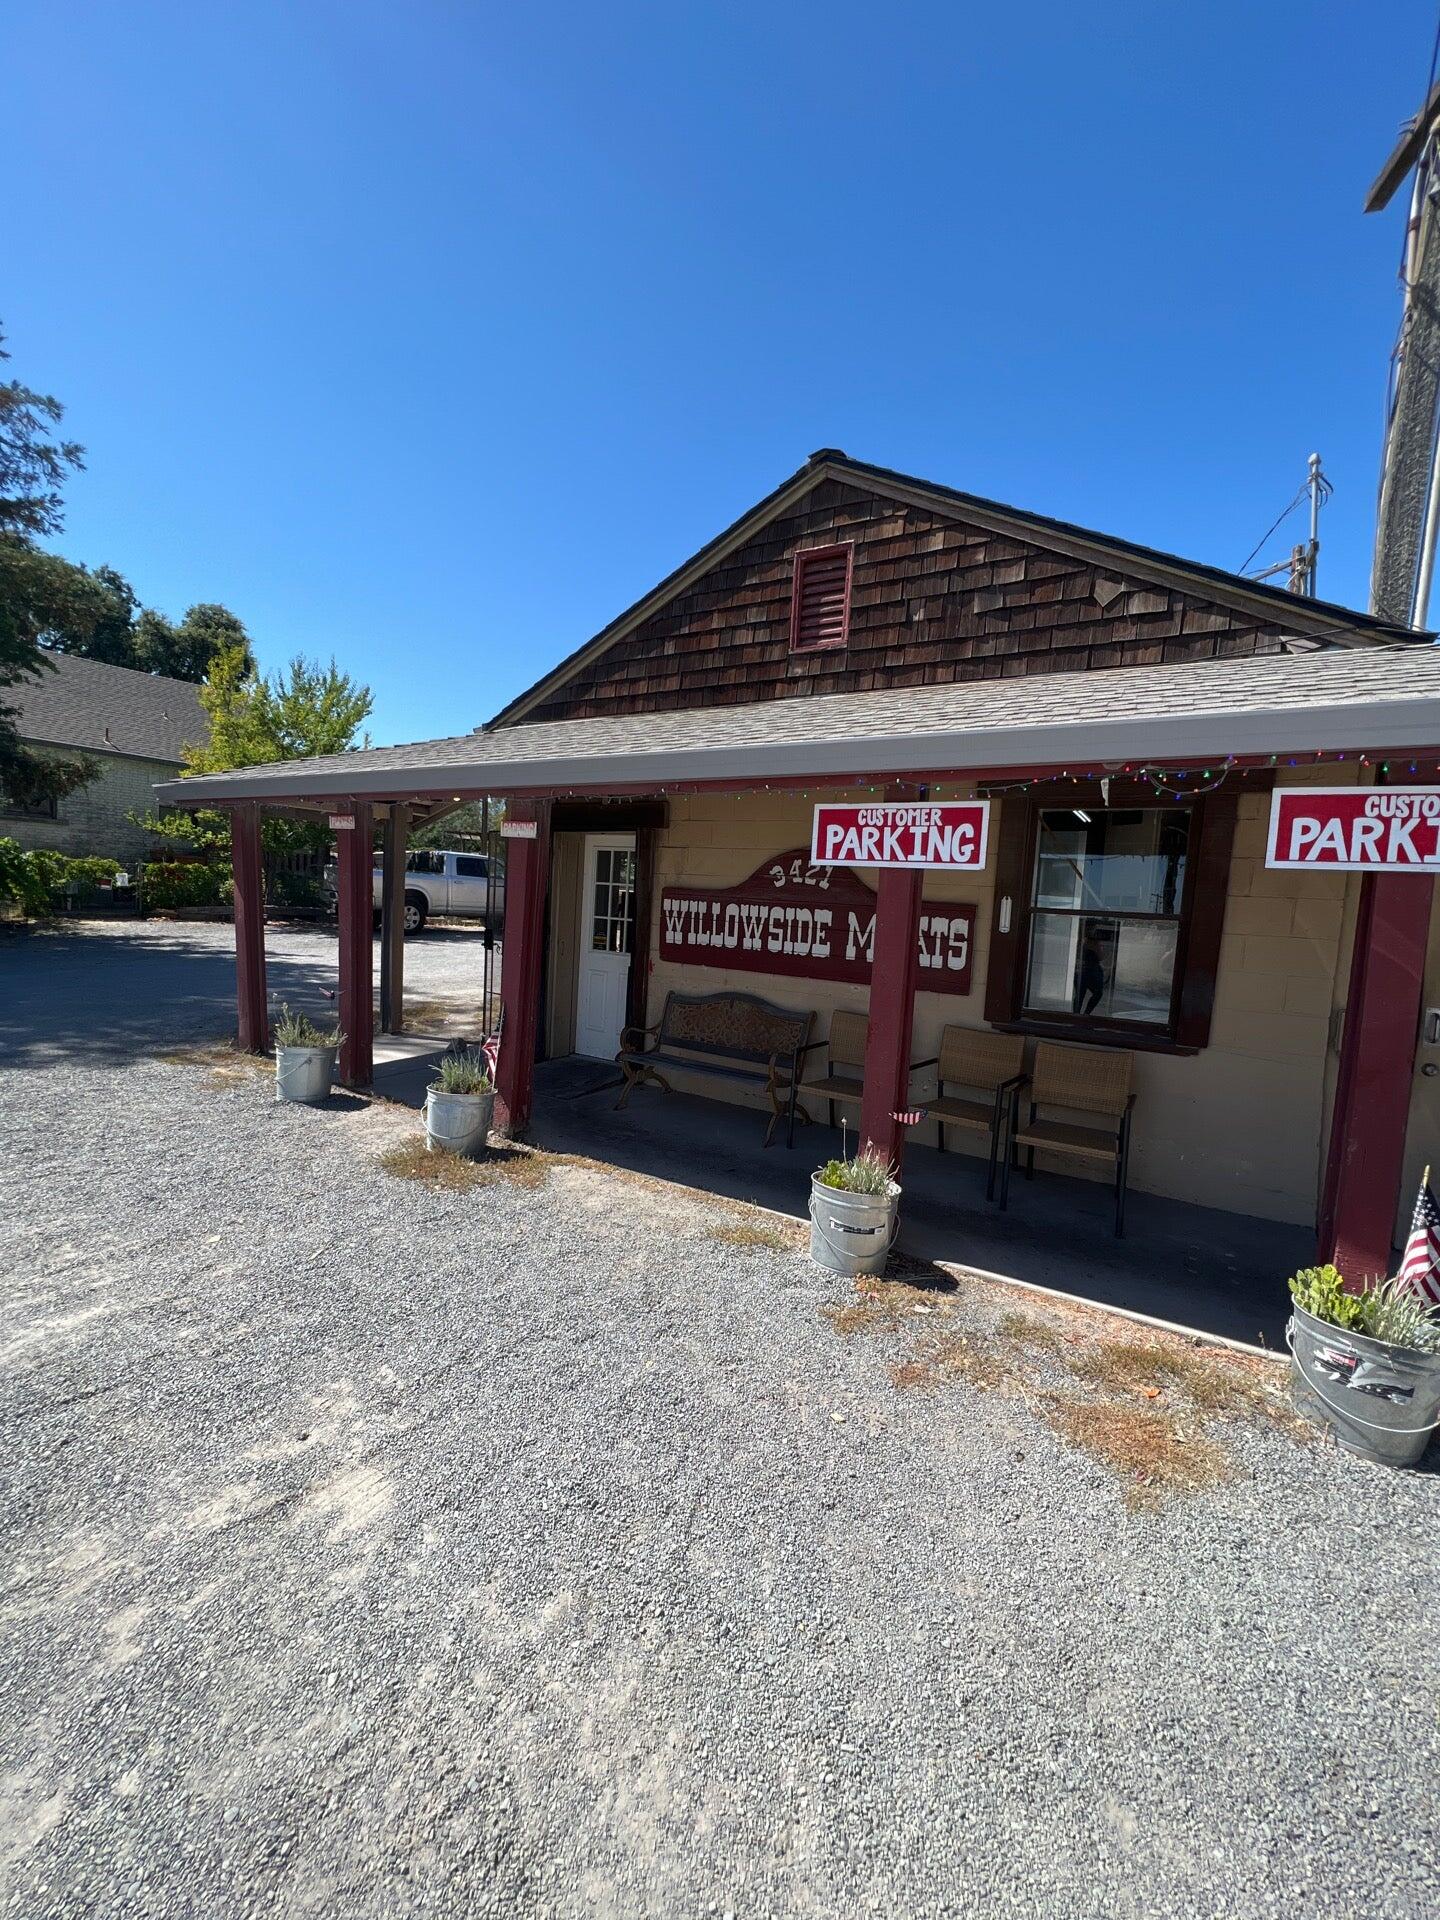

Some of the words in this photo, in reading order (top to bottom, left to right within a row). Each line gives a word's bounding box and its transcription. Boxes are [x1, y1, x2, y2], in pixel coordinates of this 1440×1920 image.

[857, 808, 942, 827] CUSTOMER
[825, 823, 975, 863] PARKING
[663, 898, 833, 958] WILLOWSIDE
